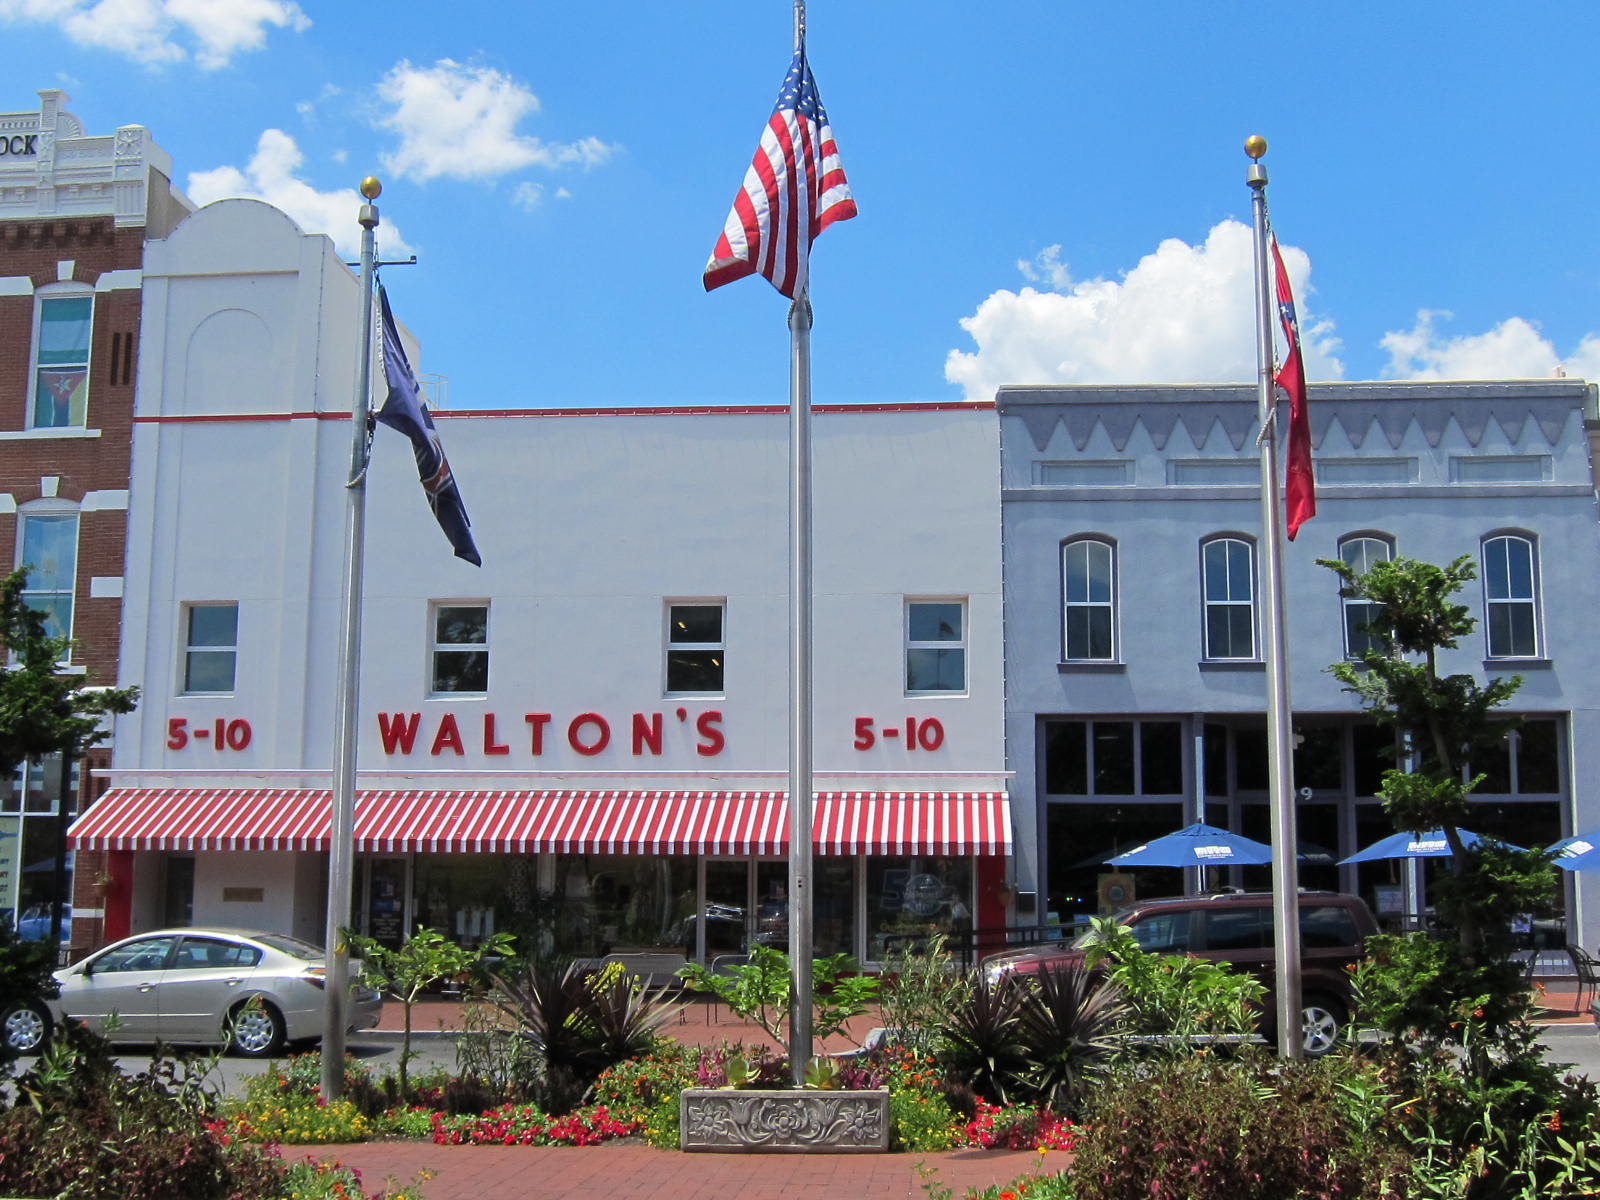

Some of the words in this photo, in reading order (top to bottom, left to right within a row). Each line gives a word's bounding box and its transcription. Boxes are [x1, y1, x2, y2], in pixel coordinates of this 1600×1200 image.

[167, 717, 252, 751] 5-10
[377, 707, 725, 757] WALTON'S
[853, 716, 945, 752] 5-10
[1295, 786, 1313, 800] 9
